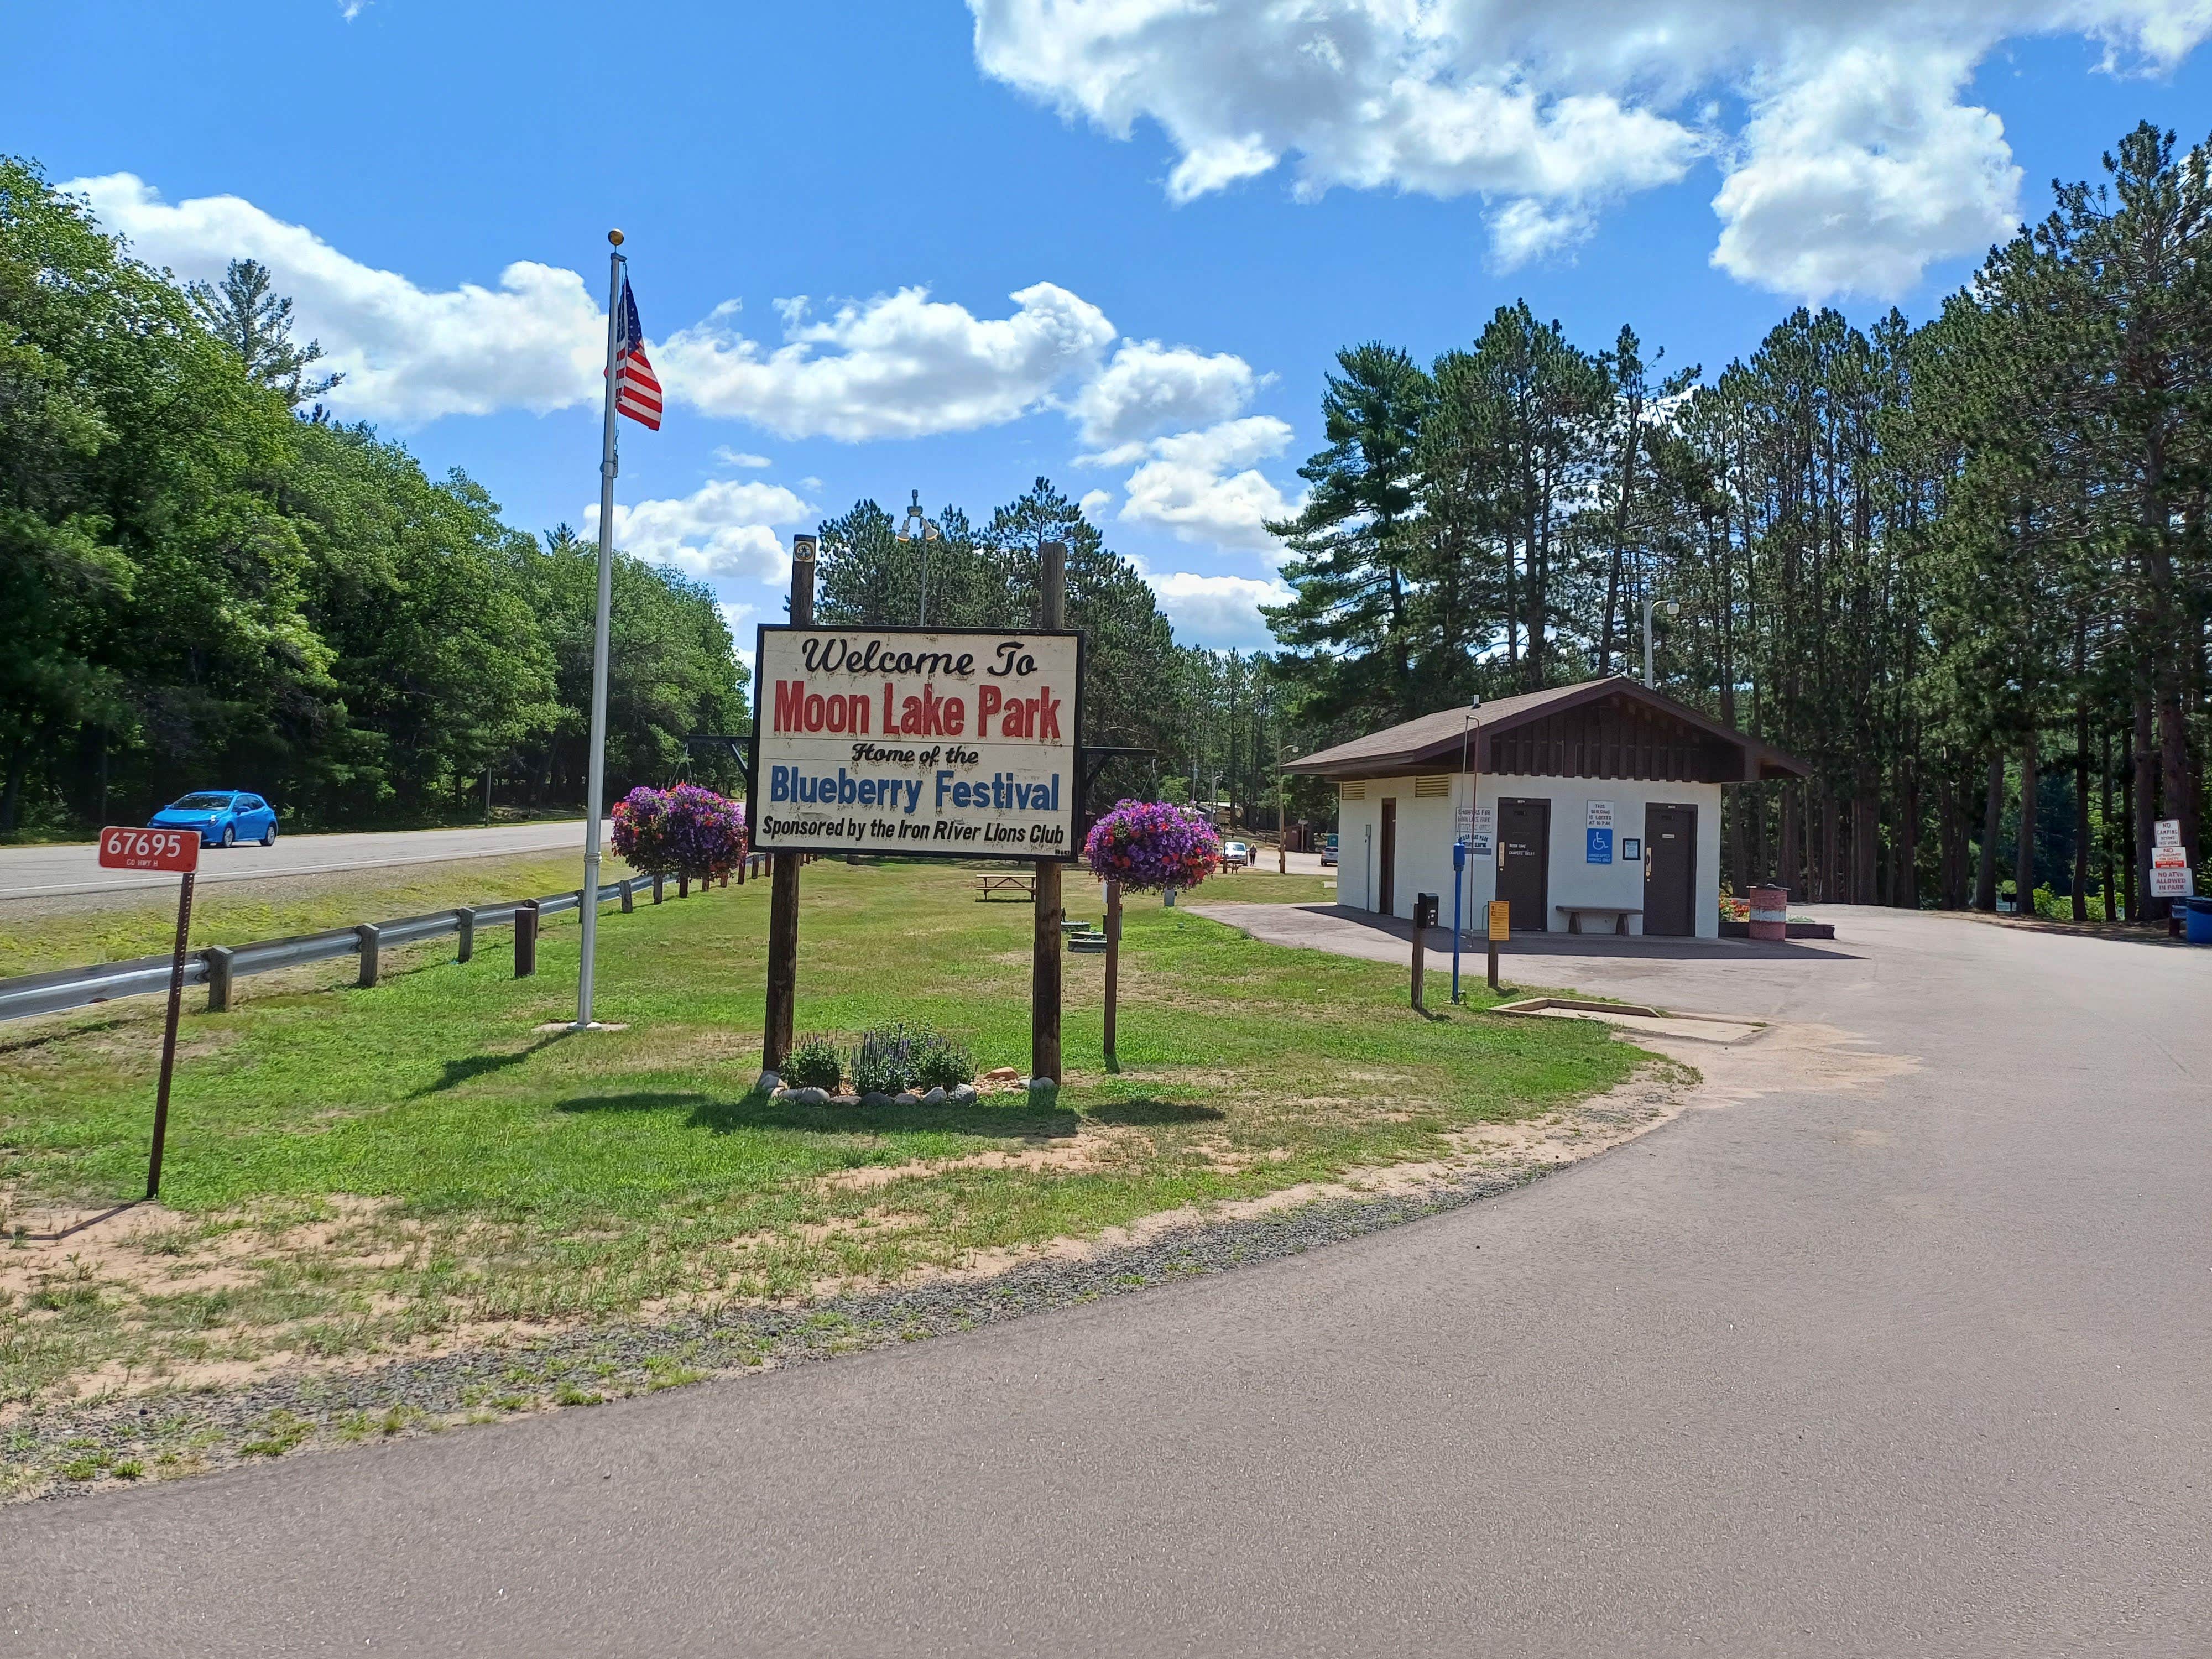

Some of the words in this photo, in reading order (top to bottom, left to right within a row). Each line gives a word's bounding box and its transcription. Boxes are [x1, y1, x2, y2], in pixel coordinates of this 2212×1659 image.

[802, 638, 974, 676] Welcome
[988, 641, 1037, 676] To
[774, 680, 870, 734] Moon
[883, 682, 964, 736] Lake
[978, 685, 1061, 738] Park
[851, 743, 915, 763] Home
[919, 745, 940, 766] of
[946, 745, 979, 764] the
[770, 765, 923, 814] Blueberry
[936, 771, 1059, 811] Festival
[107, 832, 181, 858] 67695
[762, 816, 843, 839] Sponsored
[847, 818, 867, 840] by
[870, 819, 894, 838] the
[898, 820, 930, 839] Iron
[933, 821, 980, 841] River
[984, 822, 1025, 843] Lions
[1029, 825, 1064, 844] Club
